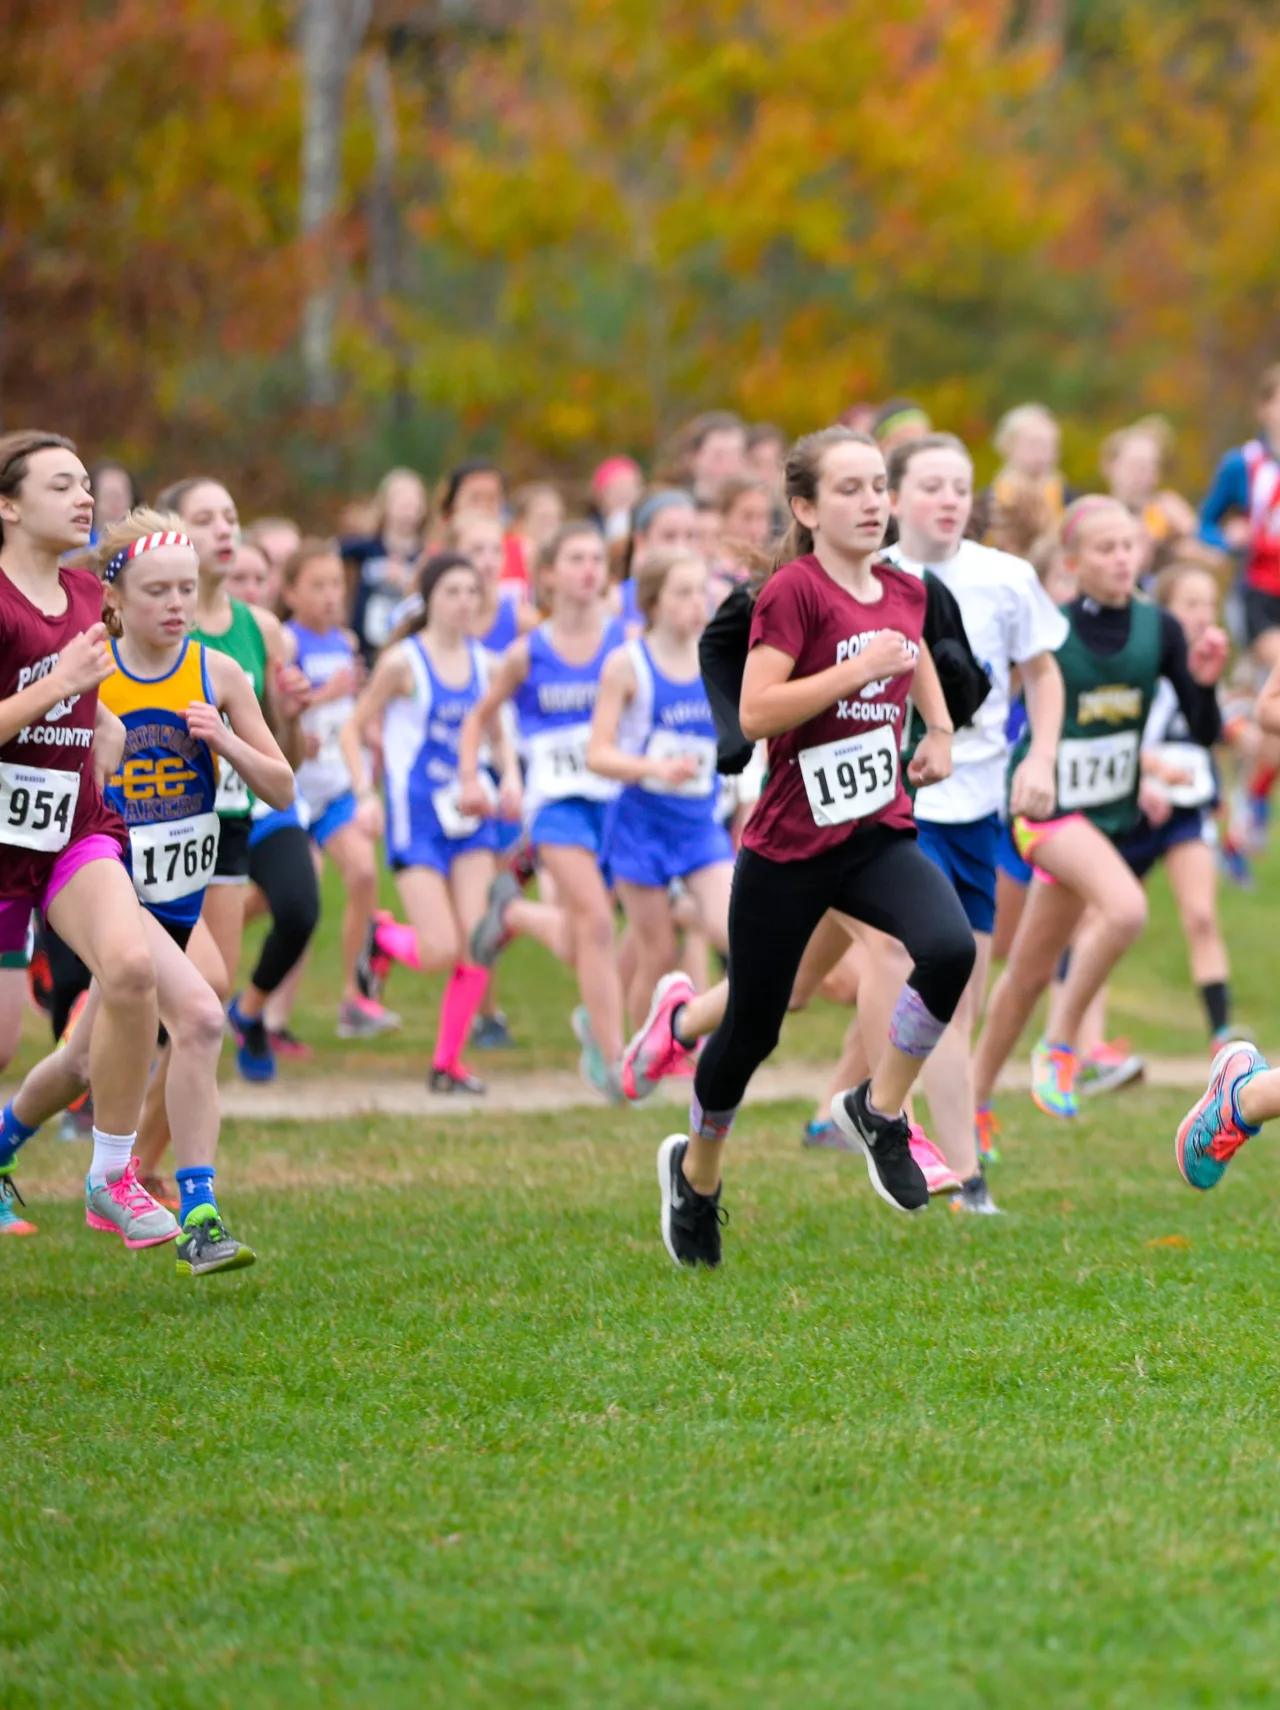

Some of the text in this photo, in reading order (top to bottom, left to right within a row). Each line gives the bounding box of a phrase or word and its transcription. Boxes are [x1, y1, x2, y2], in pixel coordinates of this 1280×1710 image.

[813, 747, 894, 807] 1953
[0, 783, 72, 833] 954
[143, 834, 216, 886] 1768
